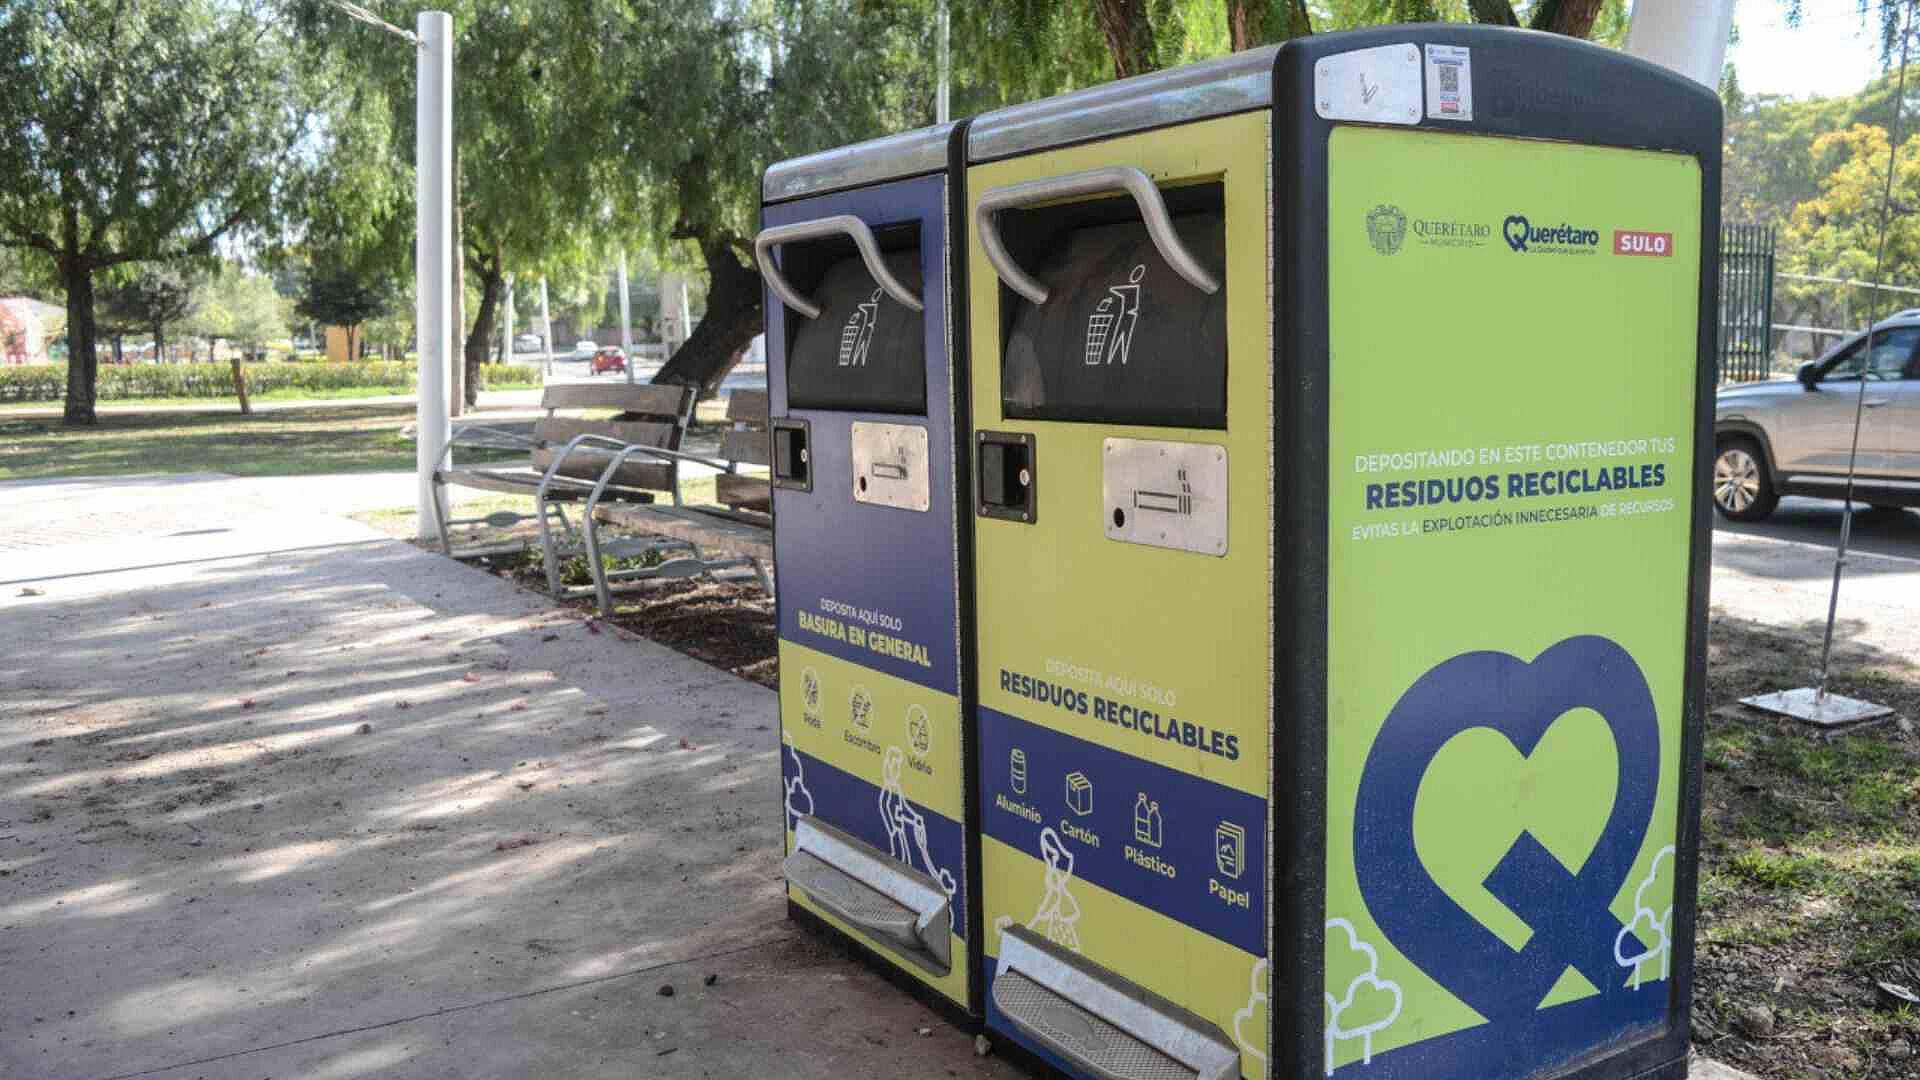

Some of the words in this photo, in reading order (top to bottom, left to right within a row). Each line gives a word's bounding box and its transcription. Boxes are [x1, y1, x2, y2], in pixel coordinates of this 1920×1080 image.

[1503, 214, 1599, 252] Querétaro
[1620, 234, 1665, 253] SULO
[1355, 449, 1474, 472] DEPOSITANDO
[1479, 448, 1500, 465] EN
[1504, 444, 1542, 463] ESTE
[1546, 438, 1648, 461] CONTENEDOR
[1650, 437, 1675, 454] TUS
[1366, 474, 1500, 510] RESIDUOS
[1507, 463, 1666, 498] RECICLABLES
[1352, 522, 1400, 540] EVITAS
[1403, 521, 1419, 536] LA
[1423, 510, 1513, 533] EXPLOTACIÓN
[1516, 507, 1598, 525] INNECESARIA
[1600, 503, 1616, 517] DE
[1620, 498, 1674, 514] RECURSOS
[820, 598, 857, 620] DEPOSITA
[859, 608, 879, 625] AQUÍ
[880, 614, 902, 631] SOLO
[799, 610, 846, 642] BASURA
[848, 625, 865, 647] EN
[868, 631, 931, 667] GENERAL
[1046, 658, 1101, 688] DEPOSITA
[1141, 681, 1176, 707] SOLO
[1000, 669, 1088, 715] RESIDUOS
[1093, 696, 1240, 761] RECICLABLES
[907, 755, 932, 775] Vidrio
[996, 793, 1042, 824] Aluminio
[1060, 819, 1100, 849] Cartón
[1124, 845, 1176, 878] Plástico
[1209, 878, 1249, 909] Papel
